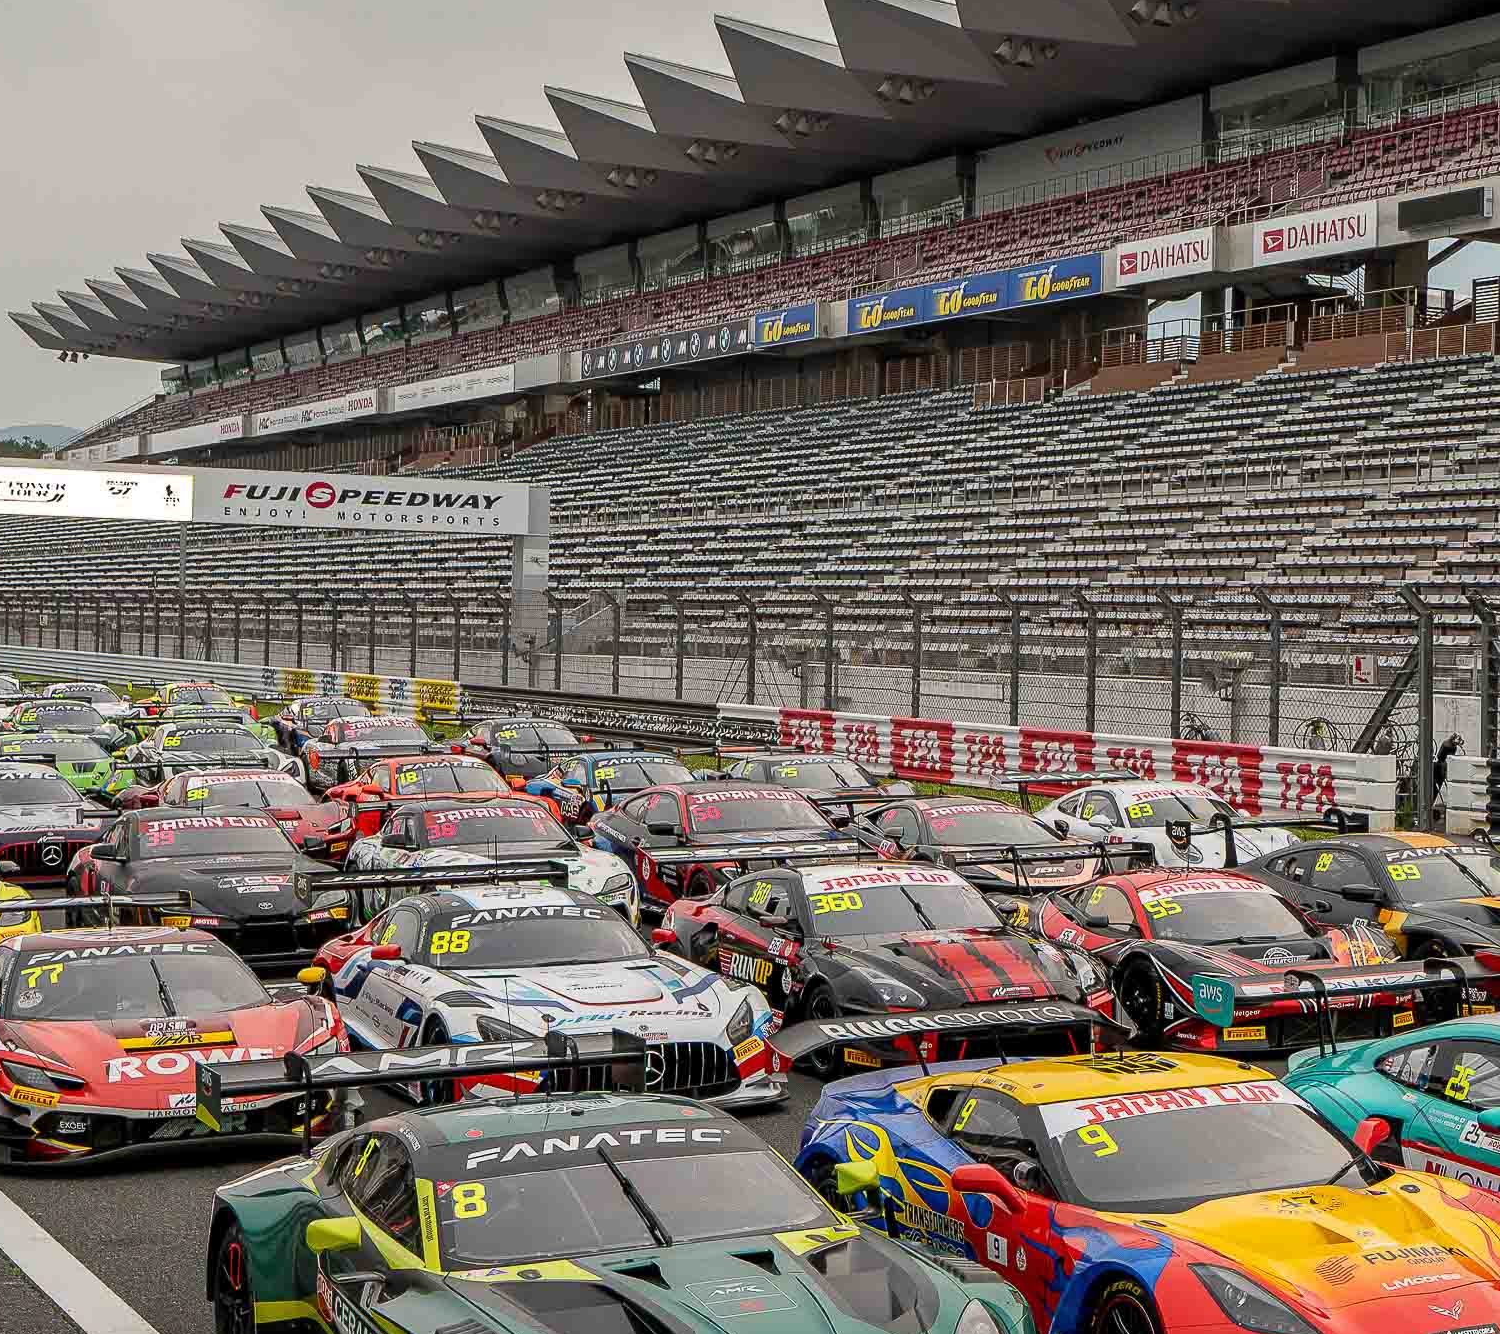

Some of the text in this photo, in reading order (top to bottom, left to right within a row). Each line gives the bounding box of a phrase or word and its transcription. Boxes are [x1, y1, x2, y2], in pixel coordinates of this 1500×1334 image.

[1287, 212, 1368, 248] DAIHATSU
[1140, 236, 1212, 272] DAIHATSU
[1025, 273, 1090, 300] GO GOODYEAR
[940, 288, 997, 316] GO GOODYEAR
[883, 307, 915, 322] GOODYEAR
[348, 397, 373, 412] HONDA
[222, 484, 302, 503] FUJI
[224, 506, 501, 527] ENJOY! MOTORSPORTS
[163, 736, 181, 747] 66
[175, 727, 246, 737] FANATEC
[402, 760, 493, 771] FANATEC
[597, 757, 675, 767] FANATEC
[594, 768, 616, 780] 93
[778, 768, 798, 777] 75
[691, 790, 798, 803] JAPAN CUP
[434, 807, 547, 823] JAPAN CUP
[1127, 803, 1155, 818] 83
[147, 816, 270, 833] JAPAN CUP
[1315, 854, 1333, 872] 89
[1385, 846, 1490, 863] FANATEC
[820, 870, 952, 891] JAPAN CUP
[1386, 863, 1421, 881] 89
[749, 882, 773, 905] 360
[1223, 878, 1266, 893] CUP
[808, 892, 863, 915] 360
[1143, 897, 1183, 920] 55
[193, 917, 219, 926] MOTUL
[451, 905, 607, 929] FANATEC
[431, 930, 471, 955] 88
[28, 943, 214, 966] FANATEC
[21, 963, 65, 988] 77
[1199, 982, 1223, 1002] aws
[1226, 1029, 1266, 1039] PIRELLI
[735, 1040, 763, 1058] PIRELLI
[1444, 1065, 1476, 1101] 25
[13, 1090, 55, 1107] PIRELLI
[1075, 1081, 1286, 1125] JAPAN CUP
[952, 1097, 978, 1132] 9
[1077, 1123, 1118, 1158] 9
[1464, 1124, 1480, 1144] 25
[354, 1138, 381, 1178] 8
[466, 1127, 726, 1171] FANATEC
[450, 1182, 488, 1219] 8
[902, 1200, 965, 1245] TRANSFORMERS
[993, 1237, 1000, 1260] 9
[1363, 1245, 1470, 1265] FUJIMAKI
[1407, 1255, 1446, 1267] GROUP
